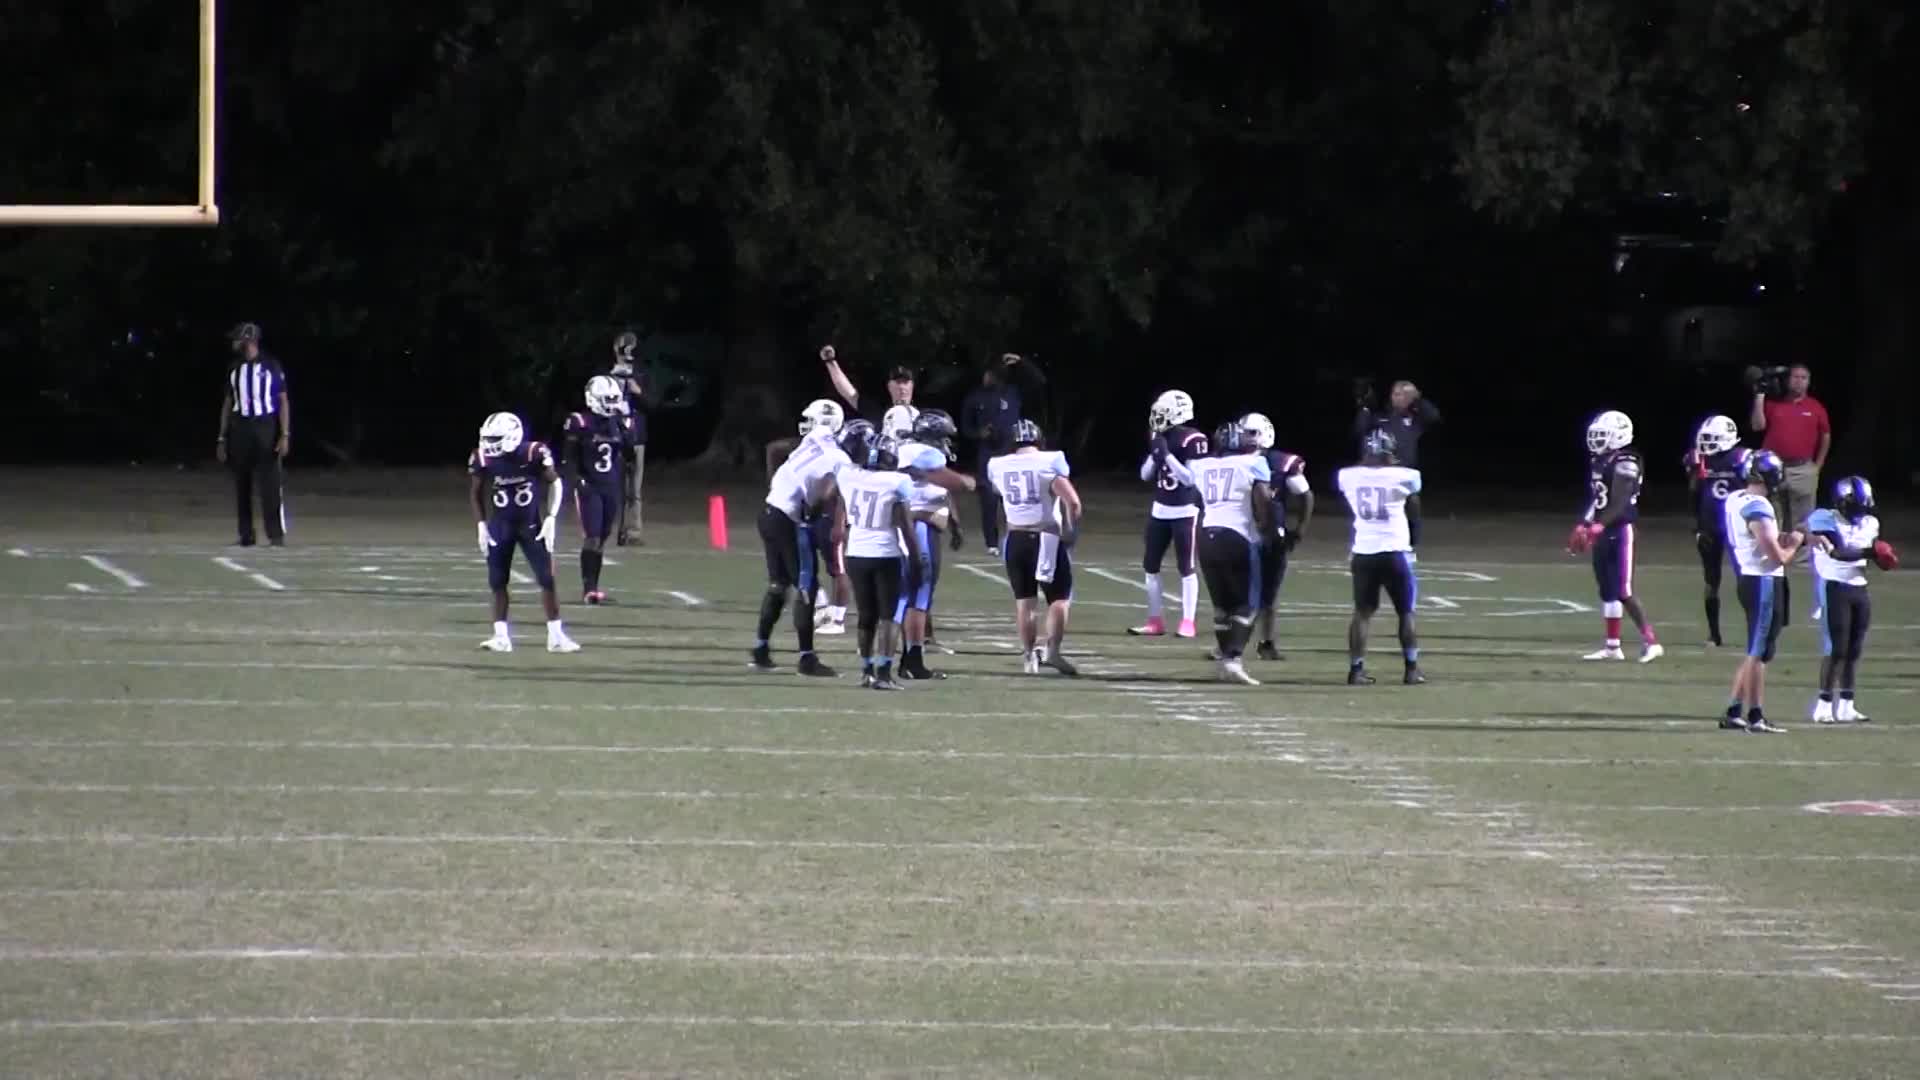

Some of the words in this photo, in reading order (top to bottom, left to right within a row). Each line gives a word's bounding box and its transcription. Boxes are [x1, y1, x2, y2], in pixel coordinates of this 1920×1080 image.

[594, 443, 612, 473] 3
[1004, 470, 1041, 505] 51
[1204, 468, 1234, 504] 67
[1712, 479, 1729, 500] 6
[849, 488, 879, 529] 47
[1356, 487, 1389, 521] 61
